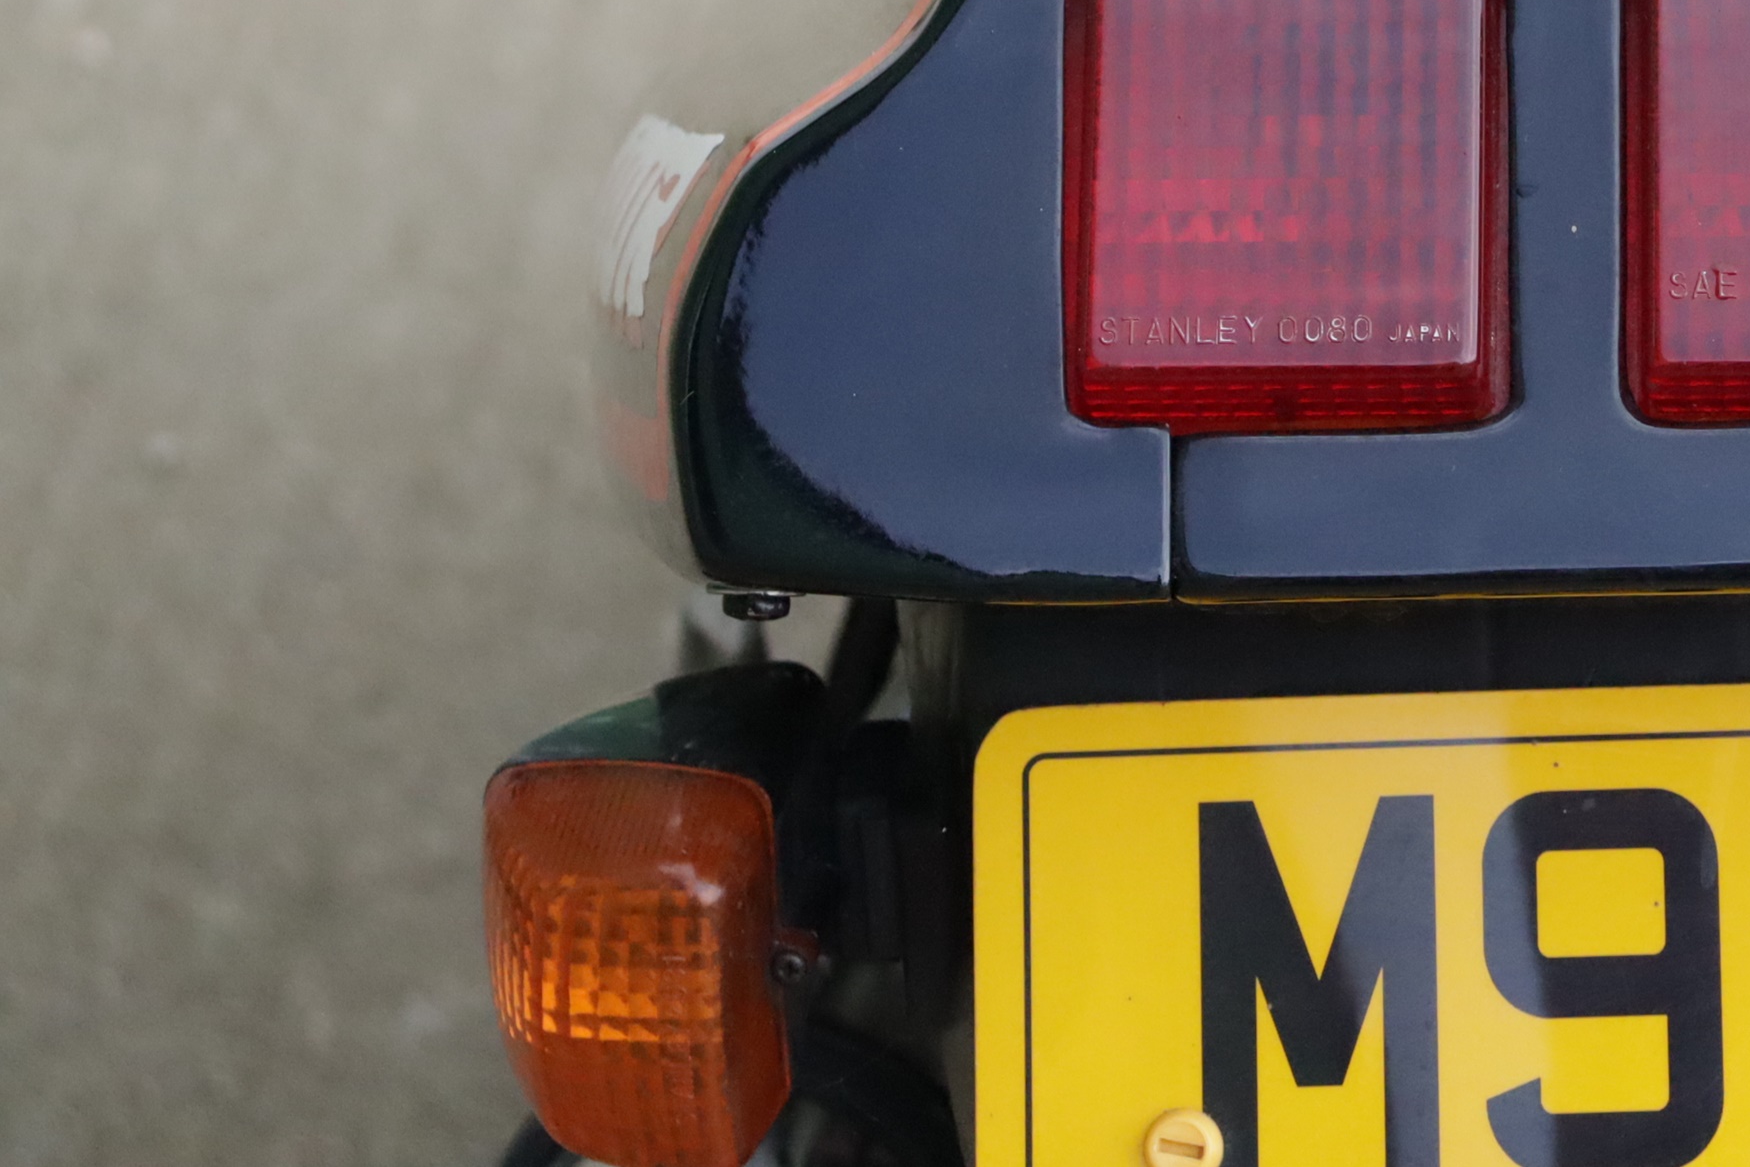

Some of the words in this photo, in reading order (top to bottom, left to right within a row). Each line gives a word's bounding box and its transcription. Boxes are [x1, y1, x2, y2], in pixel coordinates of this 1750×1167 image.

[1669, 267, 1738, 300] SAE
[1098, 314, 1263, 346] STANLEY
[1388, 322, 1461, 343] JAPAN
